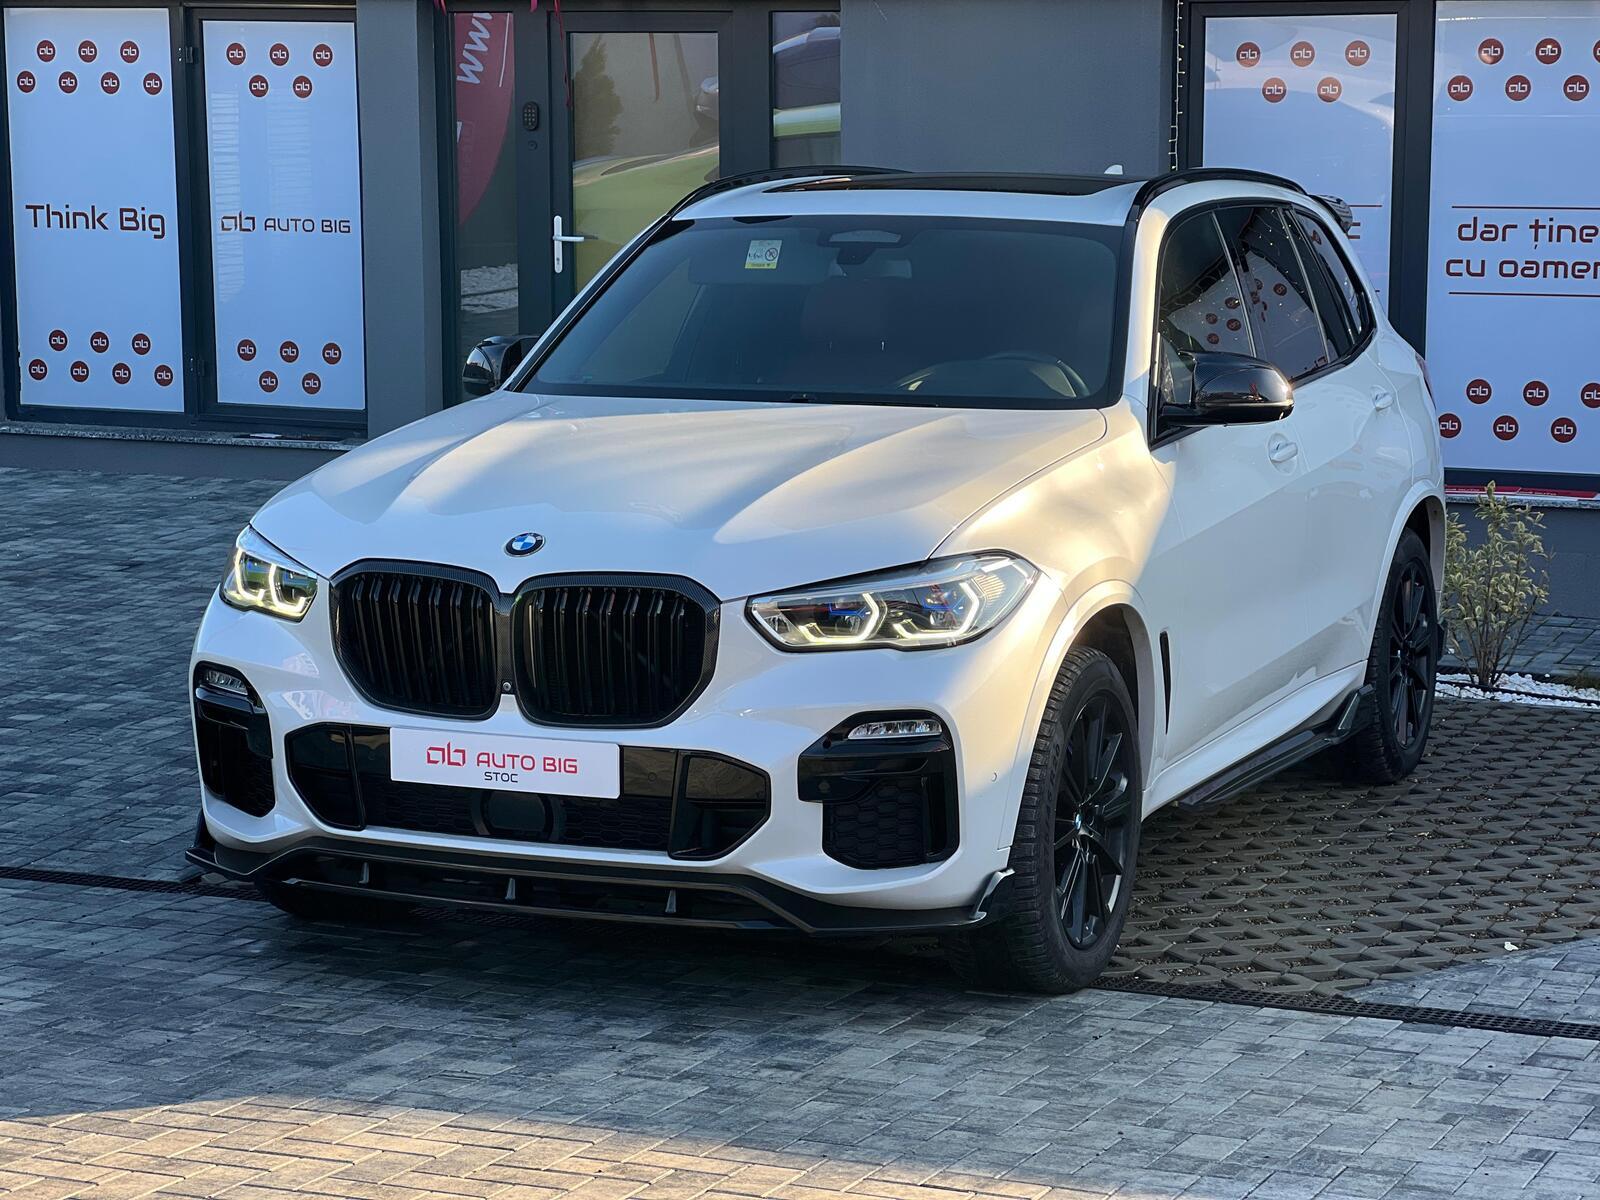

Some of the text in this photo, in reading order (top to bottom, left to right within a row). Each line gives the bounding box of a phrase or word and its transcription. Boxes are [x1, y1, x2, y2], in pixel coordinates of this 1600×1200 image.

[25, 203, 166, 240] Think Big
[264, 217, 315, 233] AUTO
[321, 219, 351, 233] BIG
[1457, 216, 1518, 242] dar
[1445, 259, 1486, 277] cu
[476, 752, 536, 771] AUTO
[543, 757, 578, 774] BIG
[484, 771, 519, 783] STOC
